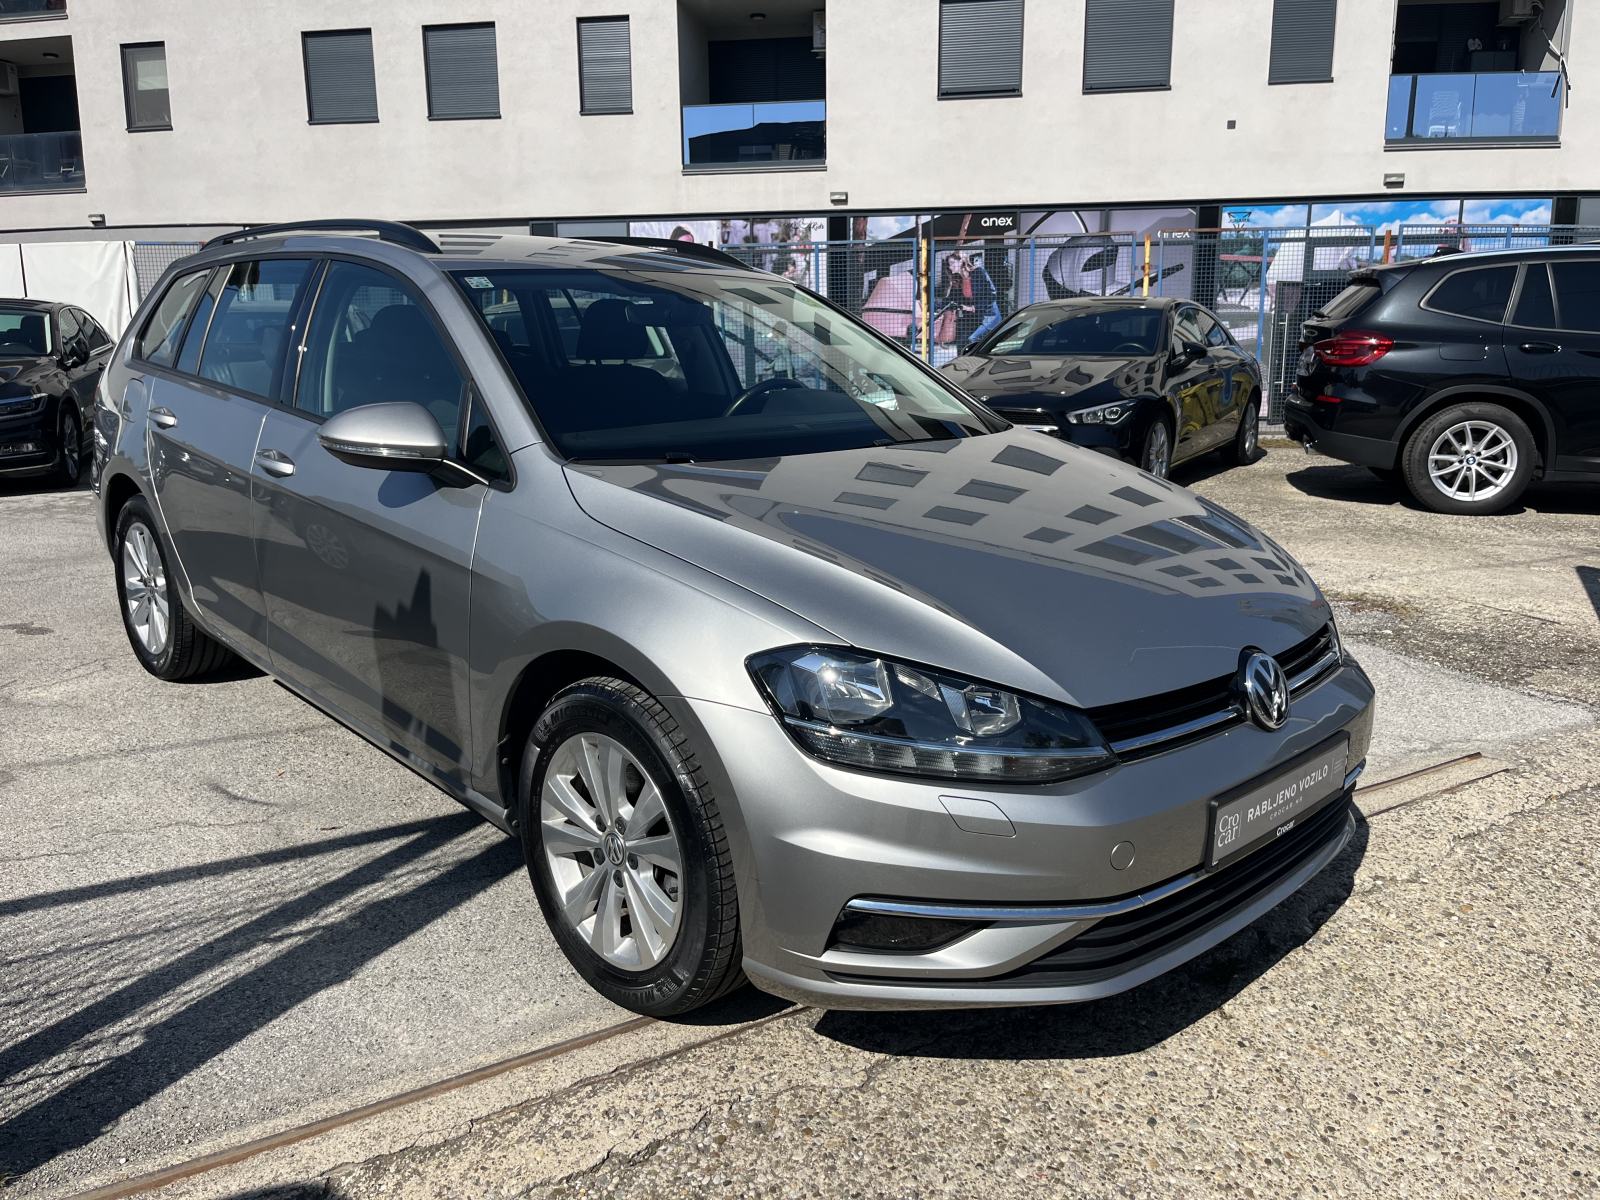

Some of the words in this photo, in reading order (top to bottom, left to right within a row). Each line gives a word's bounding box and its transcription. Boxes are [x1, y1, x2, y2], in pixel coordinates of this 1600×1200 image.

[981, 216, 1013, 227] anex
[1247, 783, 1297, 823] RABLJENO
[1299, 764, 1329, 792] VOZILO
[1219, 813, 1240, 833] Cro
[1276, 819, 1296, 837] Crocar
[1217, 825, 1239, 848] car
